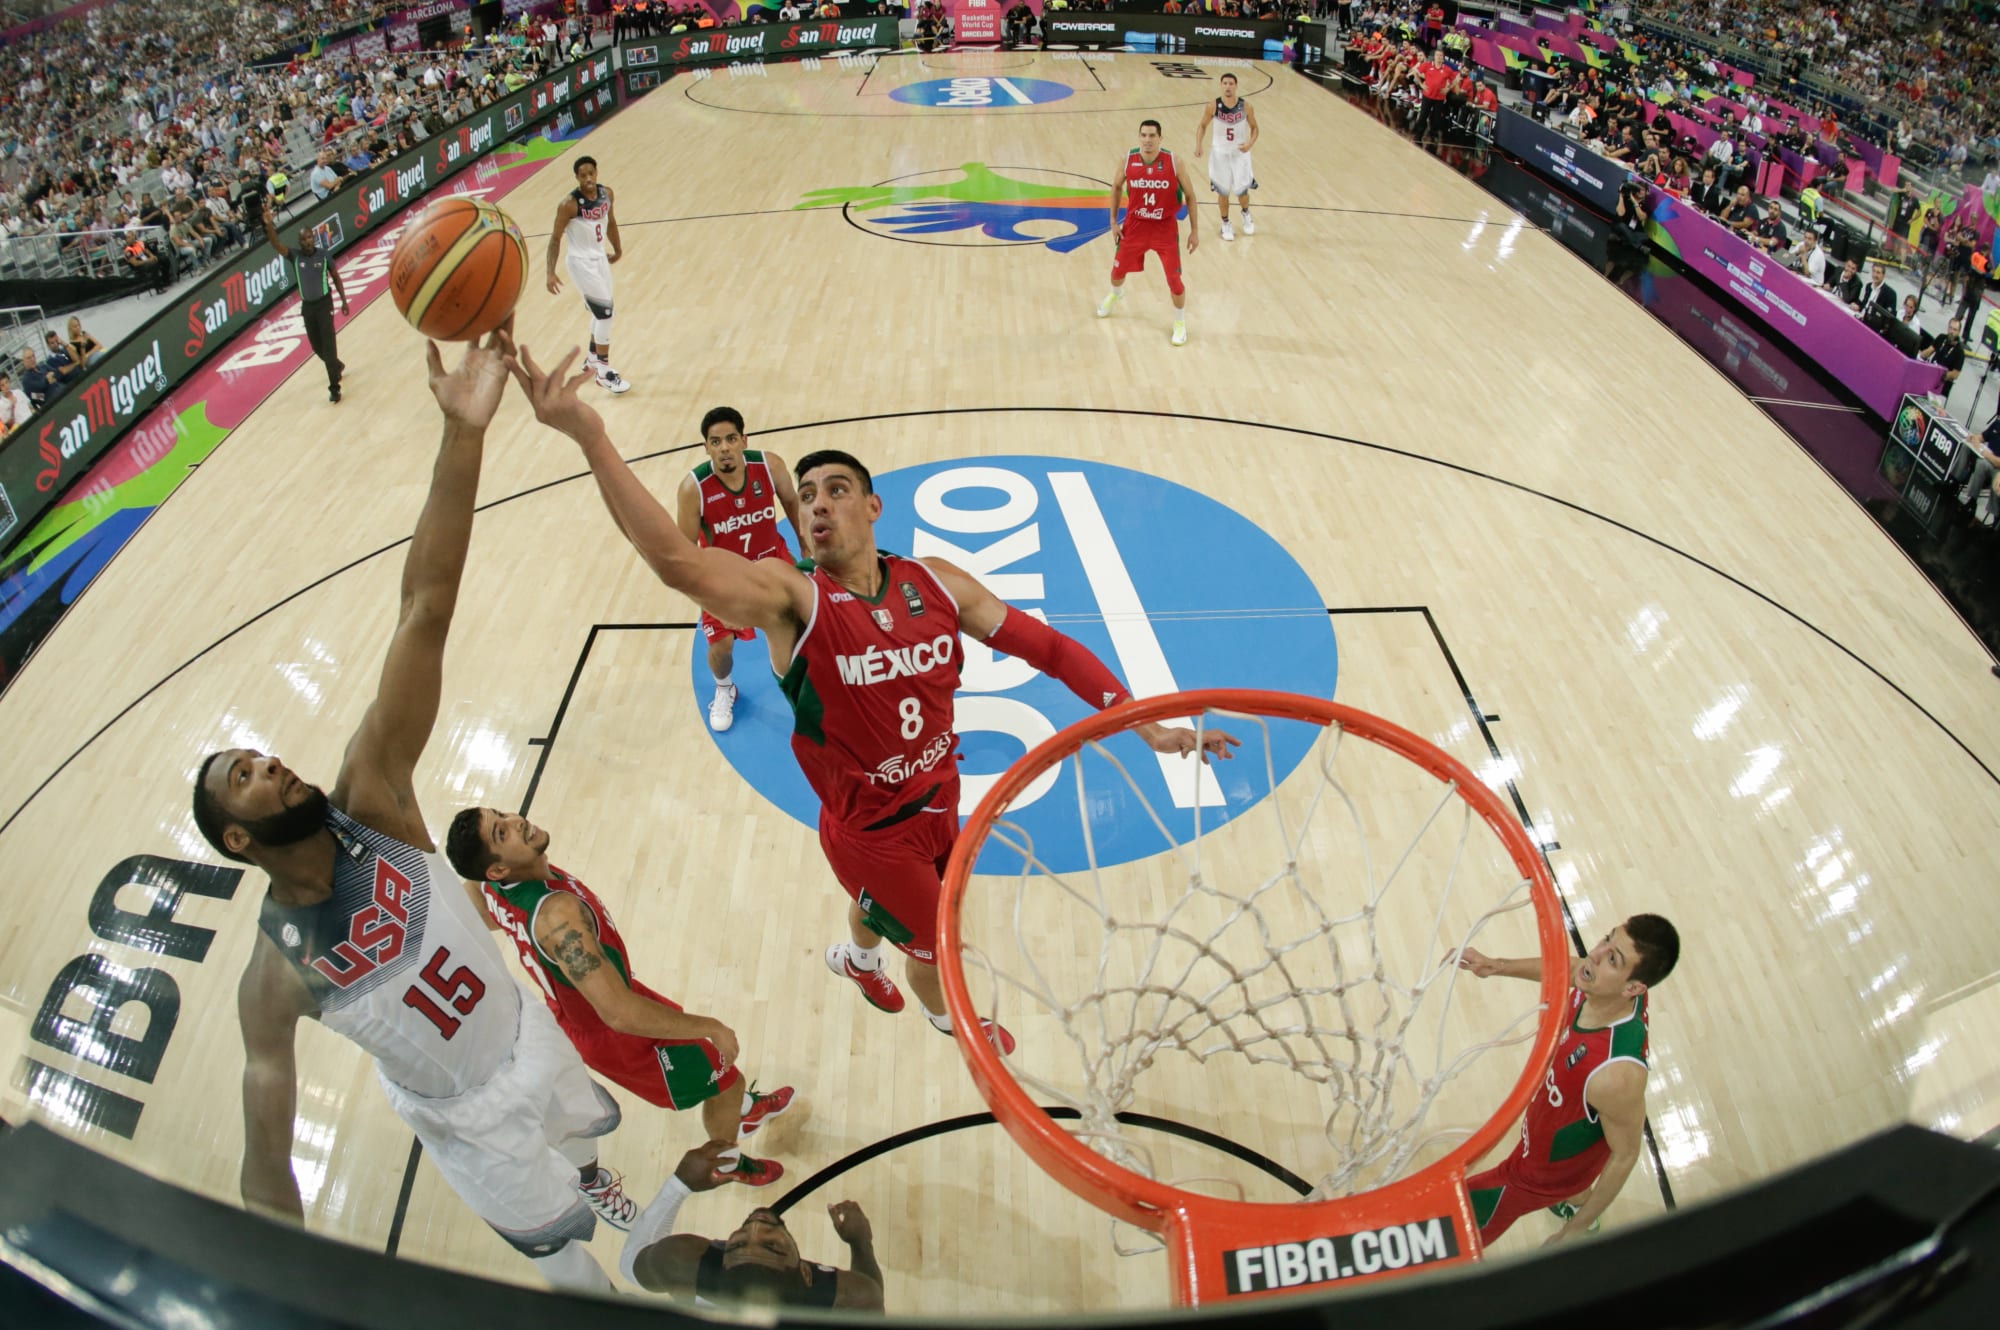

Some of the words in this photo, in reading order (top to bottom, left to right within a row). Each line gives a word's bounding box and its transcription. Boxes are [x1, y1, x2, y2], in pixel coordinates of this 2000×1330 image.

[406, 2, 455, 22] BARCELONA
[1052, 22, 1115, 31] POWERADE
[1195, 26, 1256, 38] POWERADE
[1217, 111, 1243, 123] USA
[1226, 127, 1235, 141] 5
[1143, 193, 1156, 206] 14
[582, 202, 609, 220] USA
[1930, 428, 1953, 457] FIBA
[739, 533, 752, 553] 7
[898, 696, 924, 740] 8
[311, 854, 412, 989] USA
[402, 945, 486, 1041] 15
[1235, 1217, 1448, 1293] FIBA.COM
